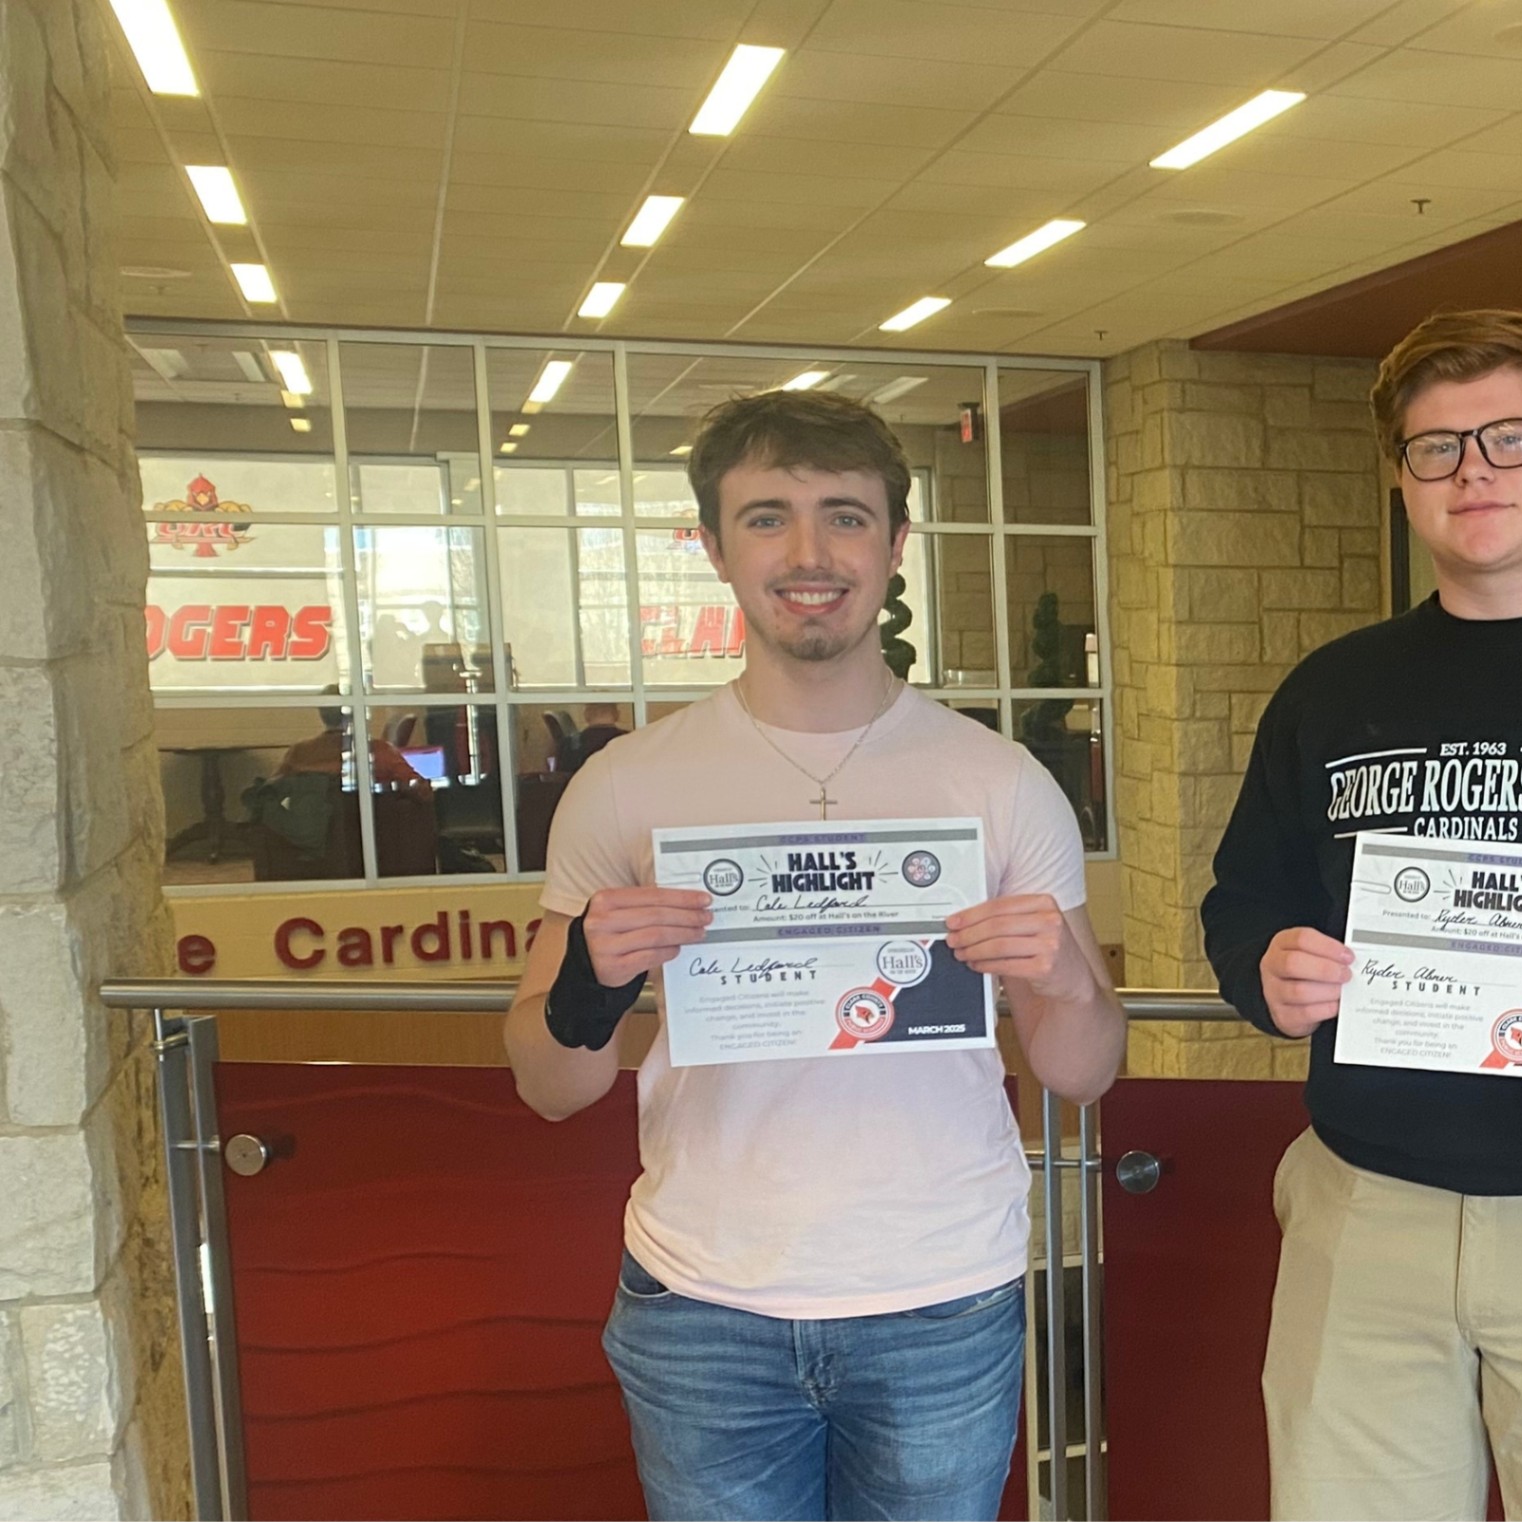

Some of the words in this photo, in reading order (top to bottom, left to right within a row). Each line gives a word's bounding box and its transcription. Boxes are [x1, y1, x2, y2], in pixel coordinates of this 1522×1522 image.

[1440, 743, 1468, 757] EST.
[1472, 742, 1507, 755] 1963
[1327, 761, 1418, 822] GEORGE
[1413, 817, 1518, 841] CARDINALS
[788, 852, 857, 872] HALL'S
[772, 871, 875, 893] HIGHLIGHT
[789, 914, 804, 922] $20
[806, 914, 819, 922] off
[863, 911, 877, 919] the
[879, 911, 899, 919] River
[777, 926, 833, 937] ENGAGED
[836, 925, 881, 935] CITIZEN
[882, 953, 923, 970] Hall's
[720, 969, 818, 986] STUDENT
[1392, 980, 1481, 996] STUDENT
[907, 1025, 940, 1035] MARCH
[941, 1023, 966, 1034] 2025
